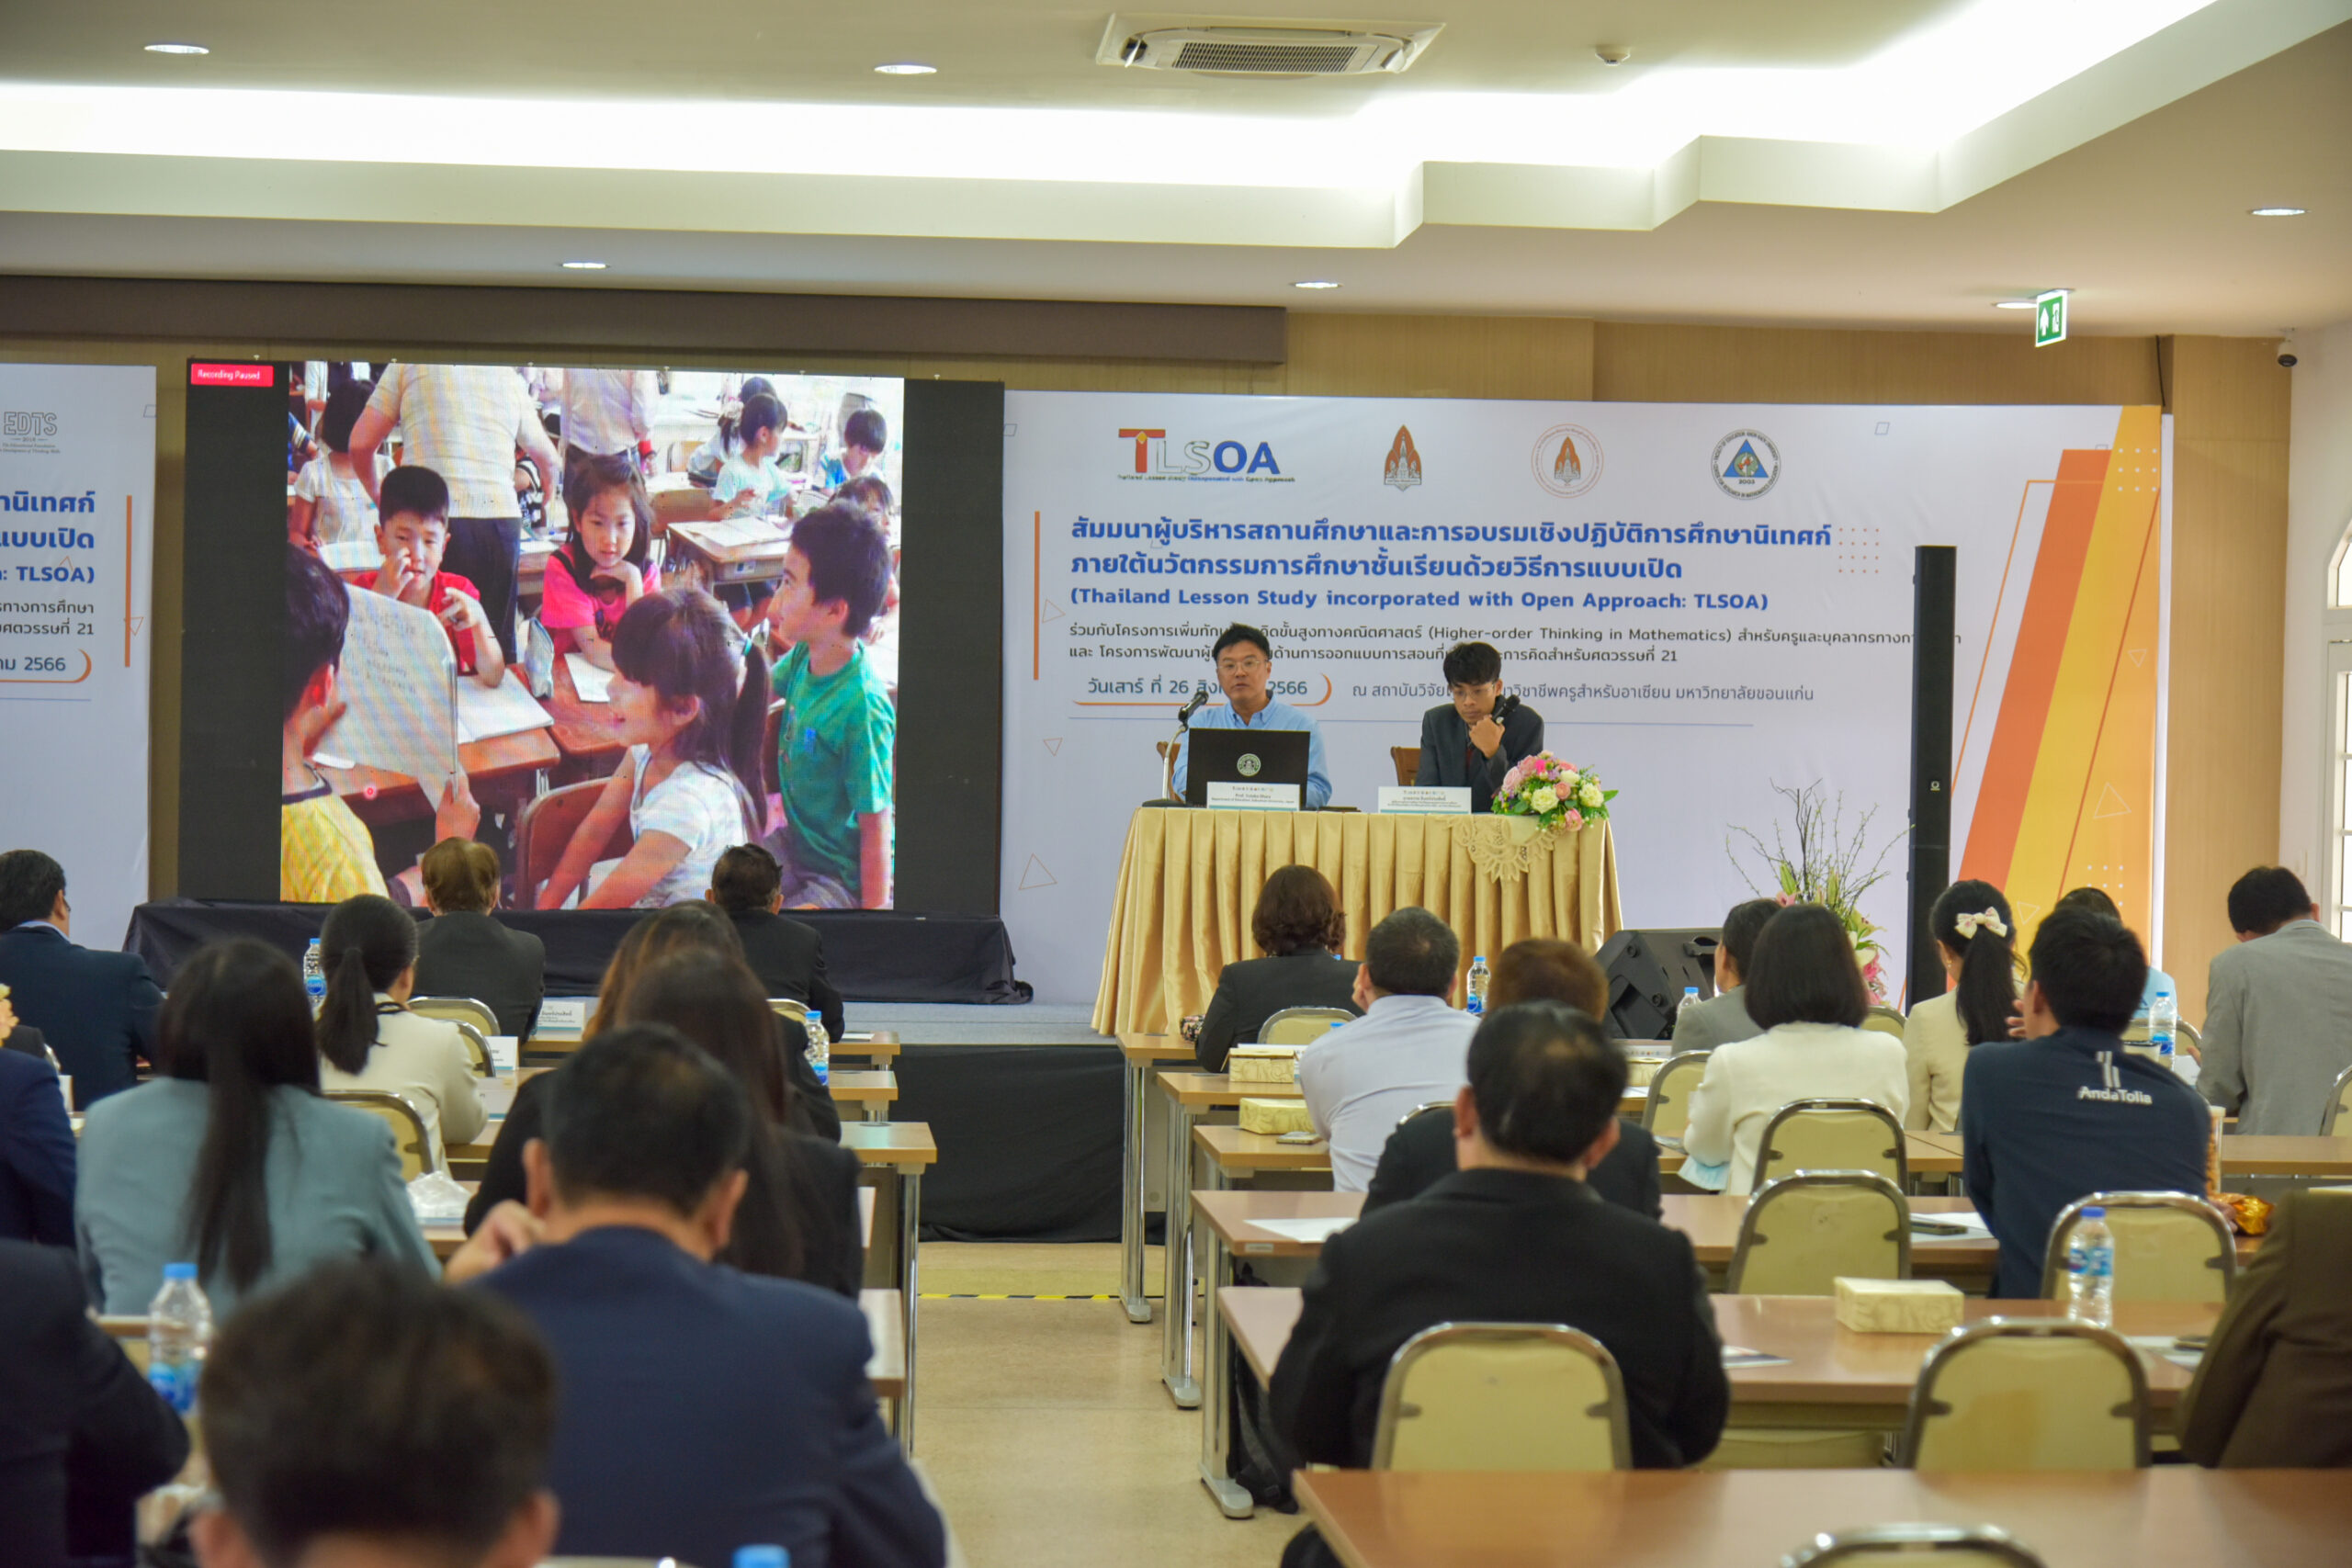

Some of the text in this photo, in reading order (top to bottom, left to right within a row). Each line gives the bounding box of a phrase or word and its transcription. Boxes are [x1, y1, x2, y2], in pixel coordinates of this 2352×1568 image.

[198, 368, 260, 381] Recording Paused
[4, 412, 58, 436] EDTS
[1118, 428, 1281, 475] TLSOA
[16, 566, 95, 583] TLSOA)
[1071, 588, 1769, 612] (Thailand Lesson Study incorporated with Open Approach: TLSOA)
[77, 623, 94, 635] 21
[1429, 626, 1533, 641] (Higher-order
[1540, 627, 1603, 642] Thinking
[1610, 628, 1623, 640] in
[1629, 628, 1732, 644] Mathematics)
[1069, 648, 1093, 658] และ
[1661, 650, 1678, 662] 21
[24, 657, 66, 671] 2566
[1088, 676, 1144, 694] วันเสาร์
[1150, 674, 1162, 694] ที่
[1170, 681, 1189, 694] 26
[1352, 685, 1366, 696] ณ
[1676, 685, 1814, 701] มหาวิทยาลัยขอนแก่น
